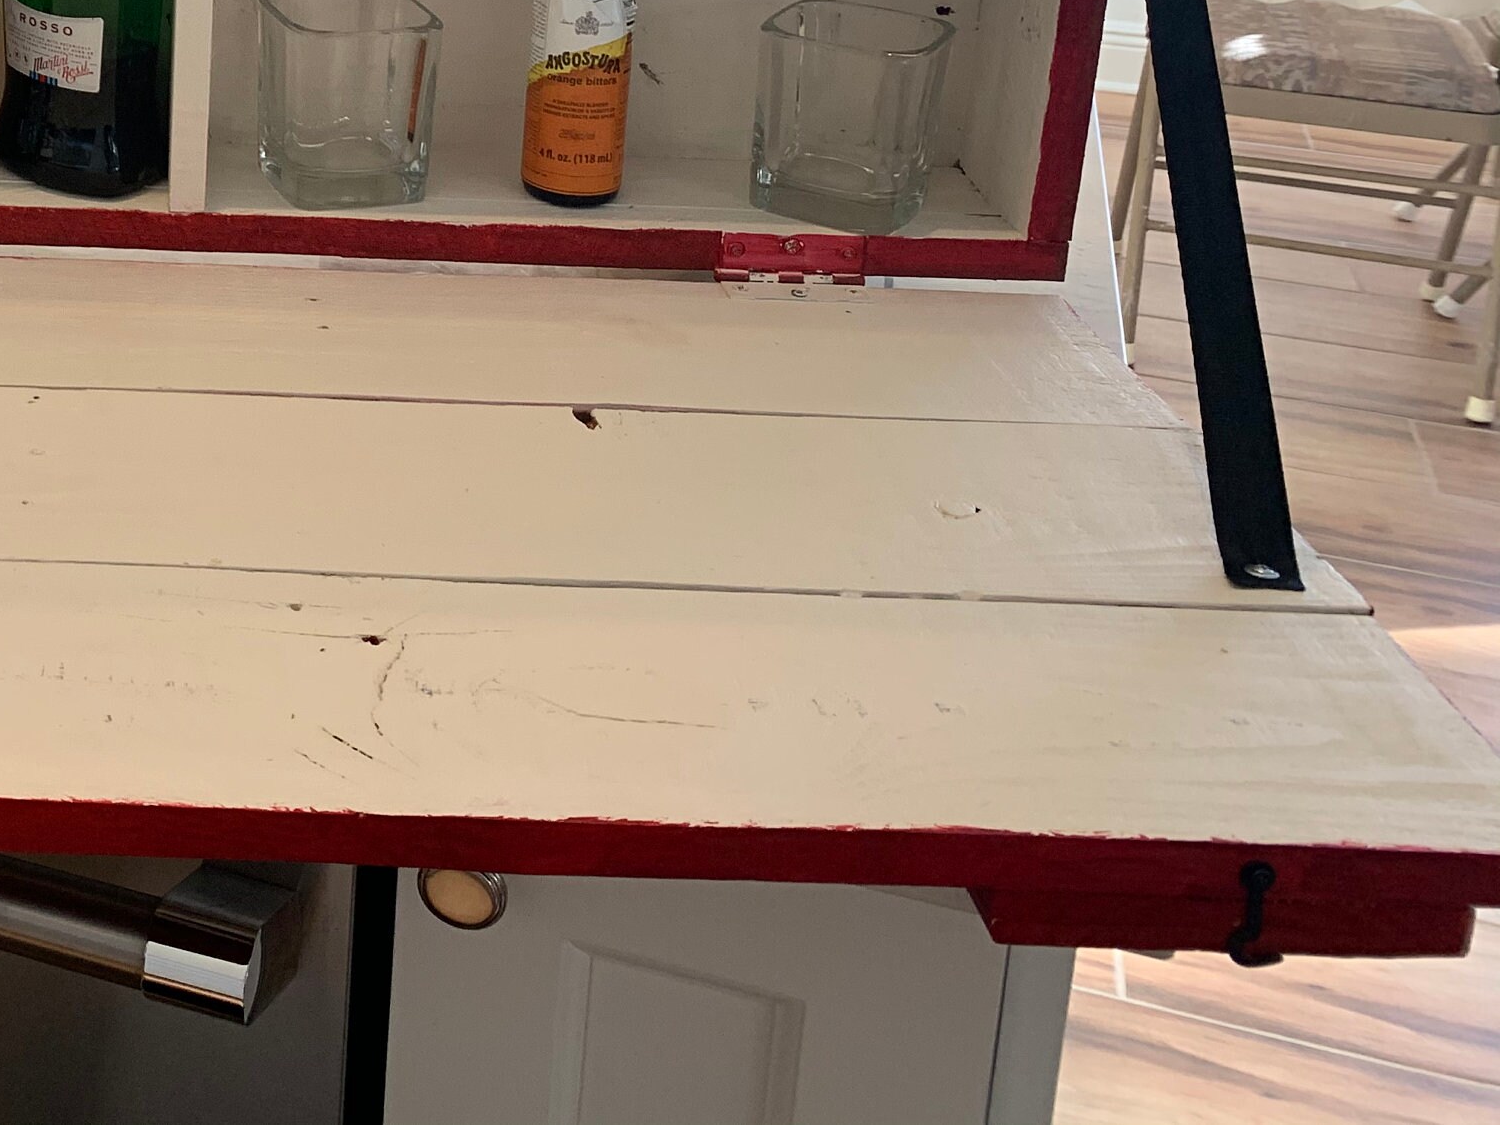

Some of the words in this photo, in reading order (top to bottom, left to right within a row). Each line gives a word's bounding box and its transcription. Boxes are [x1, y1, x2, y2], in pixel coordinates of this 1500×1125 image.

[19, 12, 73, 36] ROSSO
[545, 51, 620, 74] ANGOSTURA
[585, 76, 617, 86] bitters
[557, 153, 571, 163] oz.
[573, 153, 596, 165] (118
